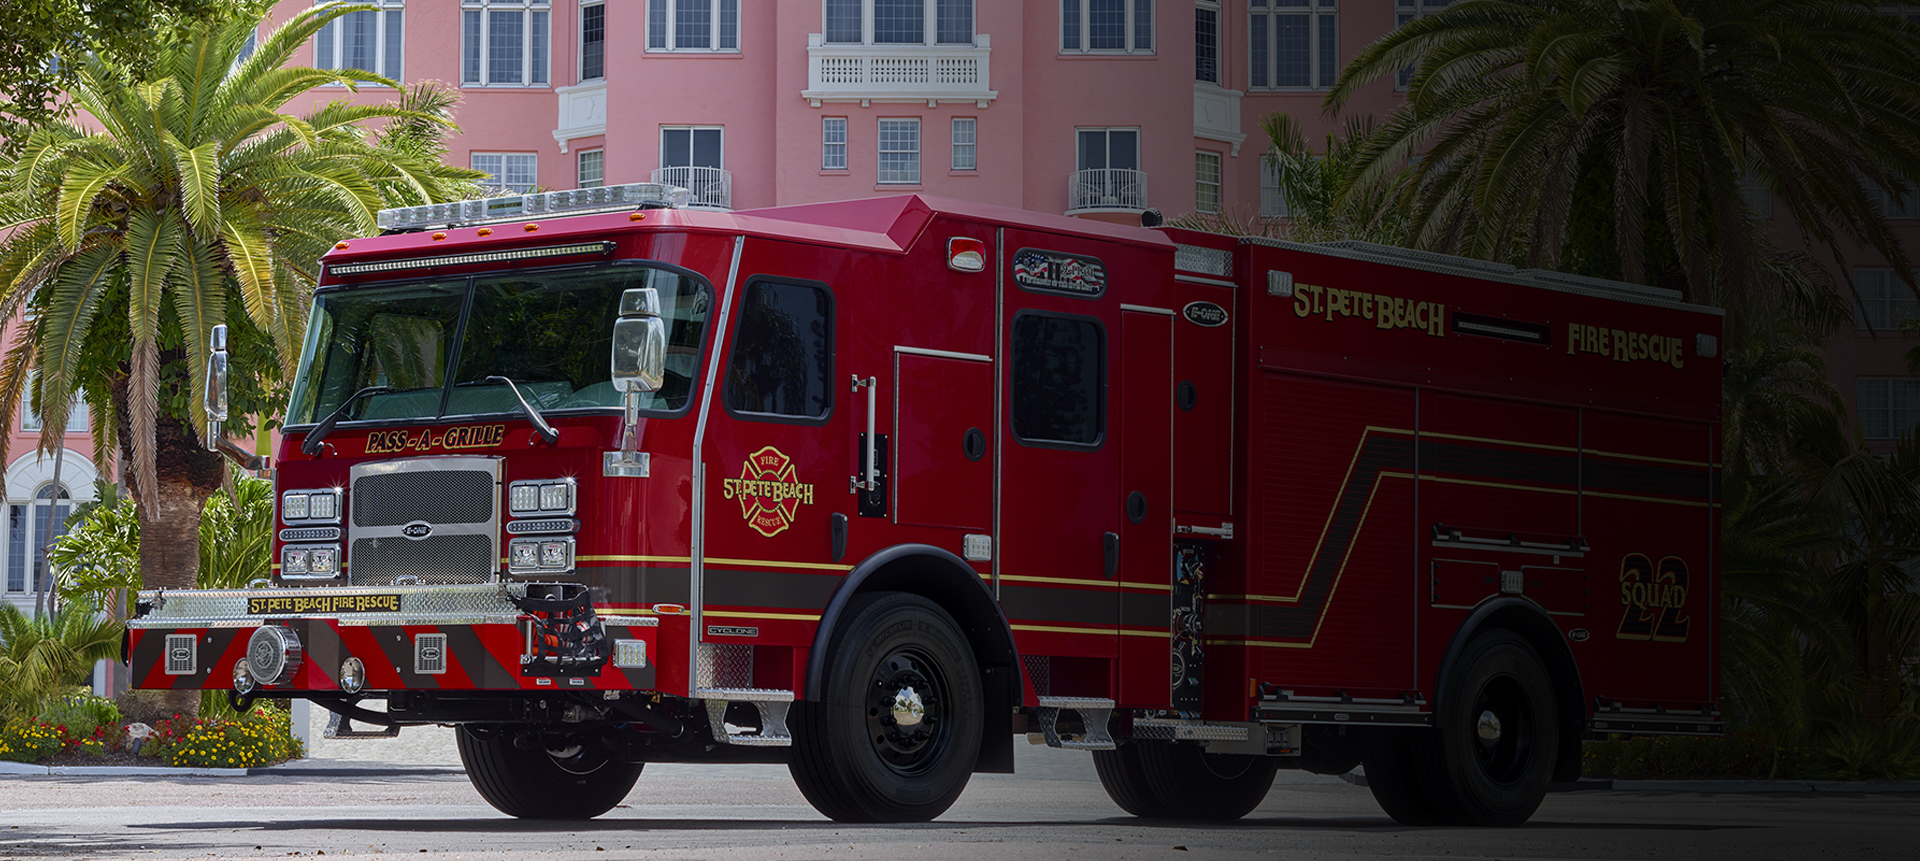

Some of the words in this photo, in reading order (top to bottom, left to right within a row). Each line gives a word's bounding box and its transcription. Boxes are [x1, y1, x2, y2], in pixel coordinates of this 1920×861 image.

[1293, 282, 1325, 318] ST.
[1325, 286, 1374, 322] PETE
[1373, 294, 1446, 338] BEACH
[1566, 321, 1611, 358] FIRE
[1610, 328, 1685, 370] RESCUE
[760, 455, 780, 467] FIRE
[723, 477, 743, 500] ST.
[742, 479, 772, 501] PETE
[771, 481, 815, 505] BEACH
[756, 515, 782, 527] RESCUE
[250, 598, 267, 614] ST.
[267, 597, 292, 613] PETE
[293, 597, 331, 613] BEACH
[332, 596, 355, 612] FIRE
[355, 595, 398, 612] RESCUE
[1620, 580, 1687, 612] SQUAD
[708, 626, 756, 635] CYCLONE
